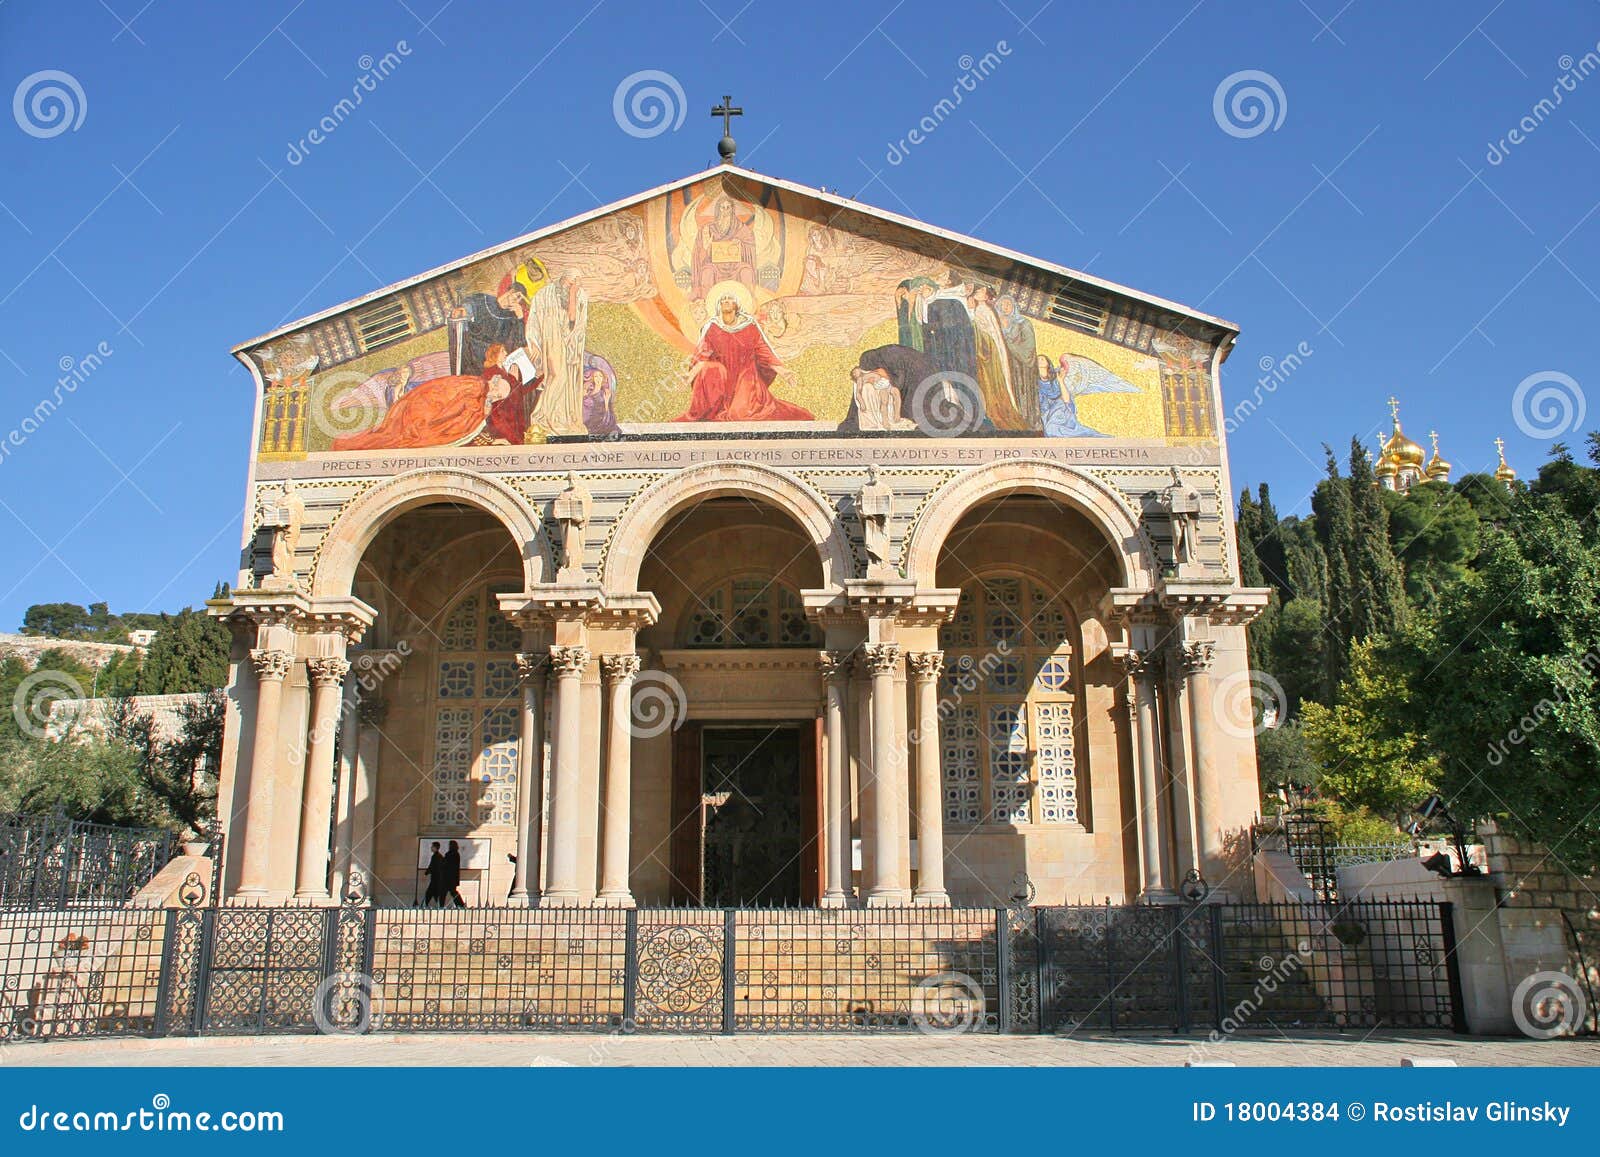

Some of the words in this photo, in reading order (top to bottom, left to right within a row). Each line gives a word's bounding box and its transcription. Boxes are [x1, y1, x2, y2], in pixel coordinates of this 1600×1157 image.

[322, 460, 372, 471] PRECES
[381, 455, 520, 469] SVPPLICATIONESQVE
[528, 455, 555, 465] CVM
[563, 453, 625, 463] CLAMORE
[634, 451, 682, 462] VALIDO
[716, 450, 782, 461] LACRYMIS
[791, 449, 863, 460] OFFERENS
[872, 449, 949, 460] EXAVDITVS
[958, 449, 984, 459] EST
[994, 449, 1021, 459] PRO
[1031, 449, 1057, 459] SVA
[1065, 449, 1149, 460] REVERENTIA
